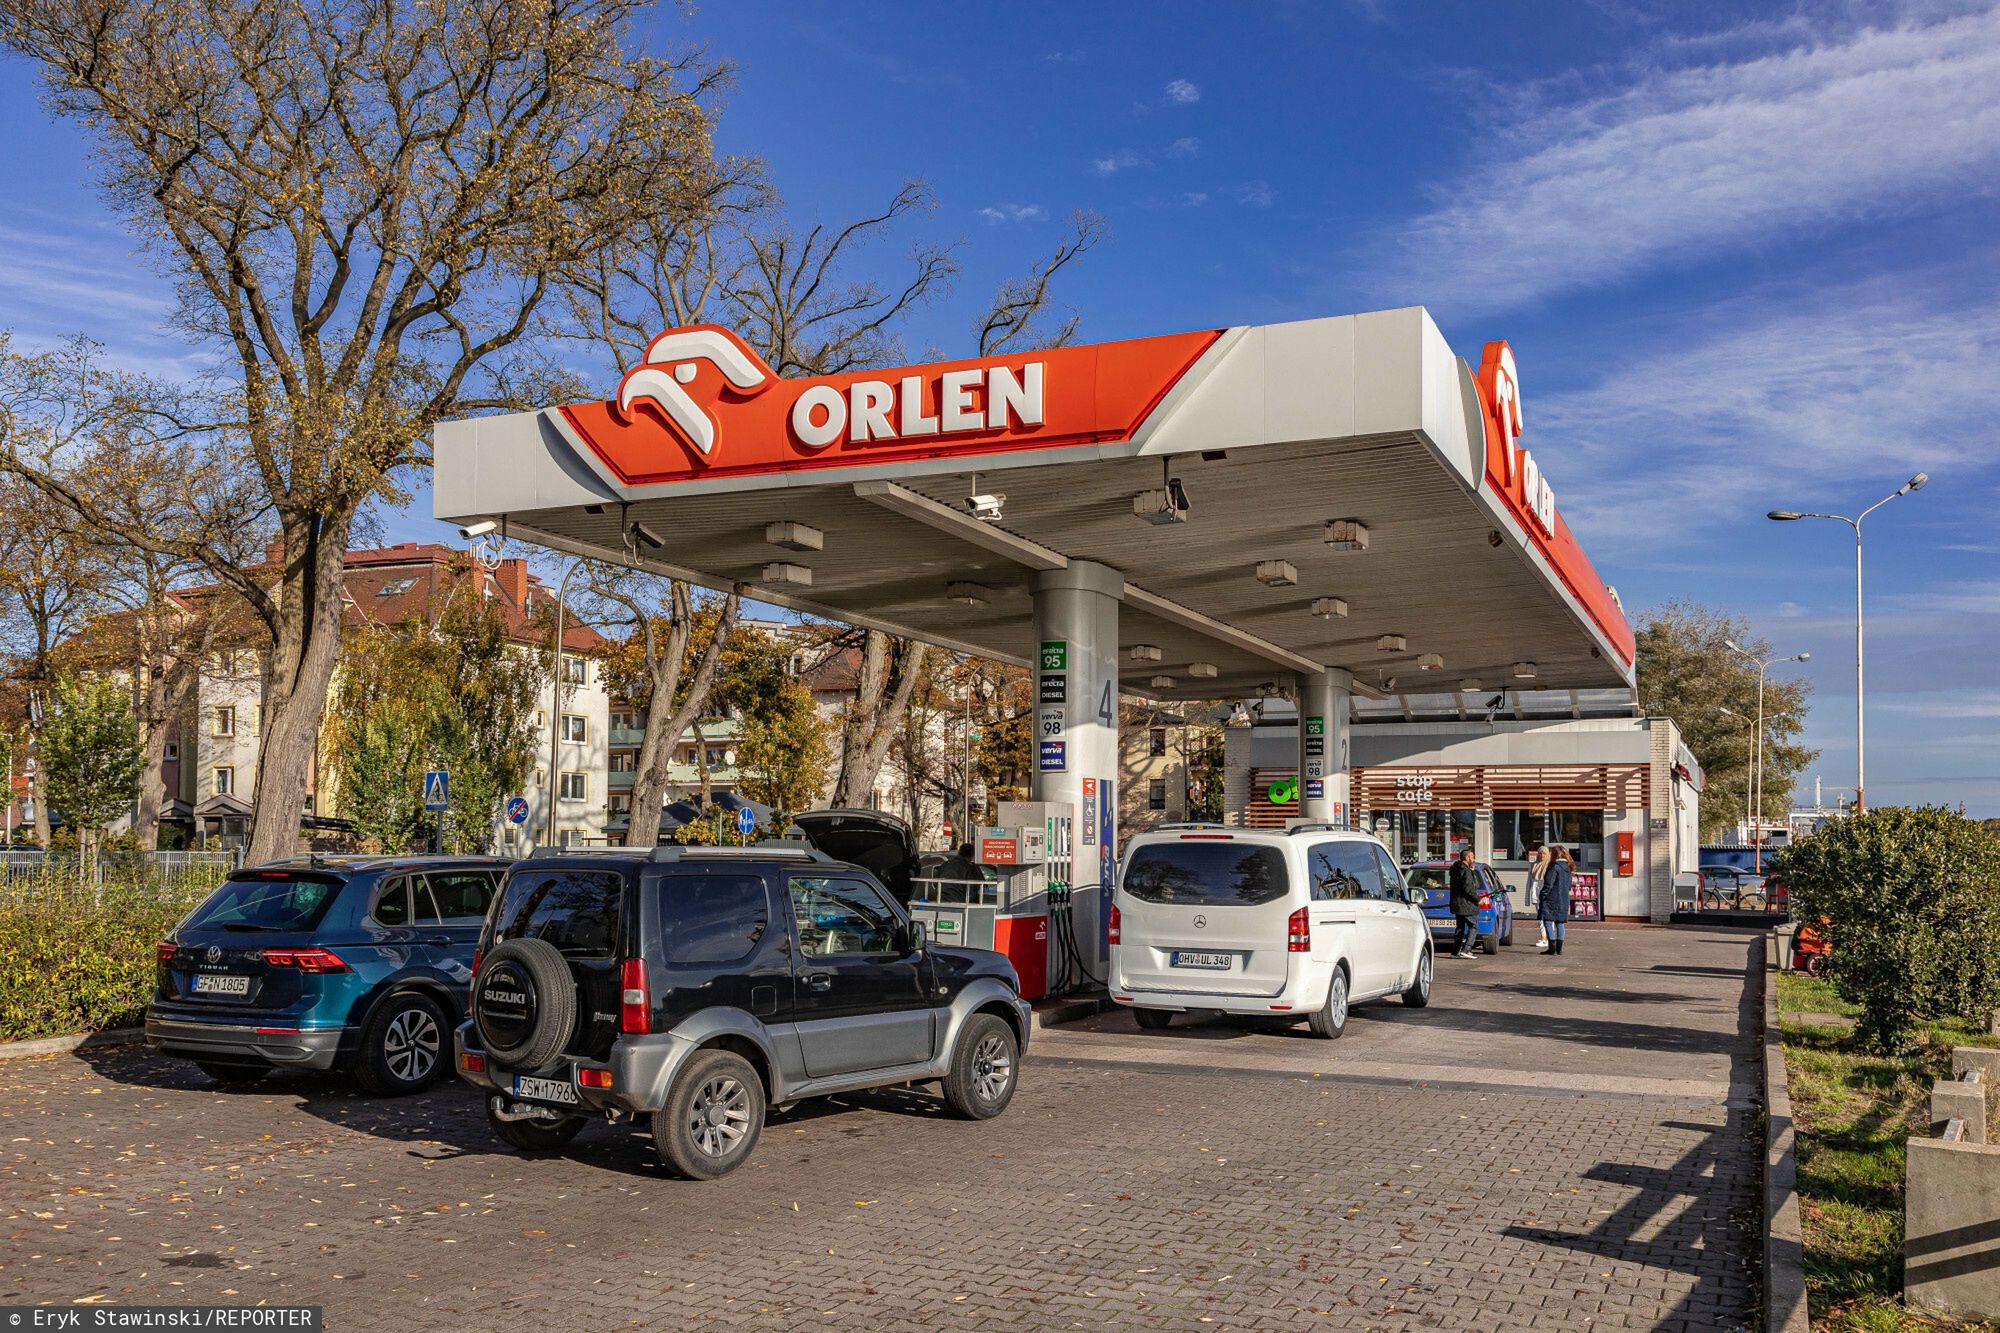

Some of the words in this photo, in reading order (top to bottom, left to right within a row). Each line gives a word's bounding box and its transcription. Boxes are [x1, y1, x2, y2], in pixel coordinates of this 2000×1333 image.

[792, 361, 1044, 447] ORLEN
[1044, 655, 1061, 668] 95
[1098, 679, 1113, 729] 4
[1041, 712, 1064, 720] verva
[1043, 721, 1061, 735] 98
[1308, 725, 1321, 734] 95
[1041, 745, 1063, 754] verva
[1341, 738, 1347, 770] 2
[1308, 767, 1321, 776] 98
[1396, 788, 1433, 803] cafe
[1179, 954, 1196, 963] OHV
[1201, 955, 1211, 965] UL
[1213, 955, 1229, 966] 348
[197, 976, 209, 989] GF
[213, 977, 221, 990] N
[221, 978, 245, 991] 1805
[484, 989, 526, 1005] SUZUKI
[520, 1078, 541, 1097] ZSW
